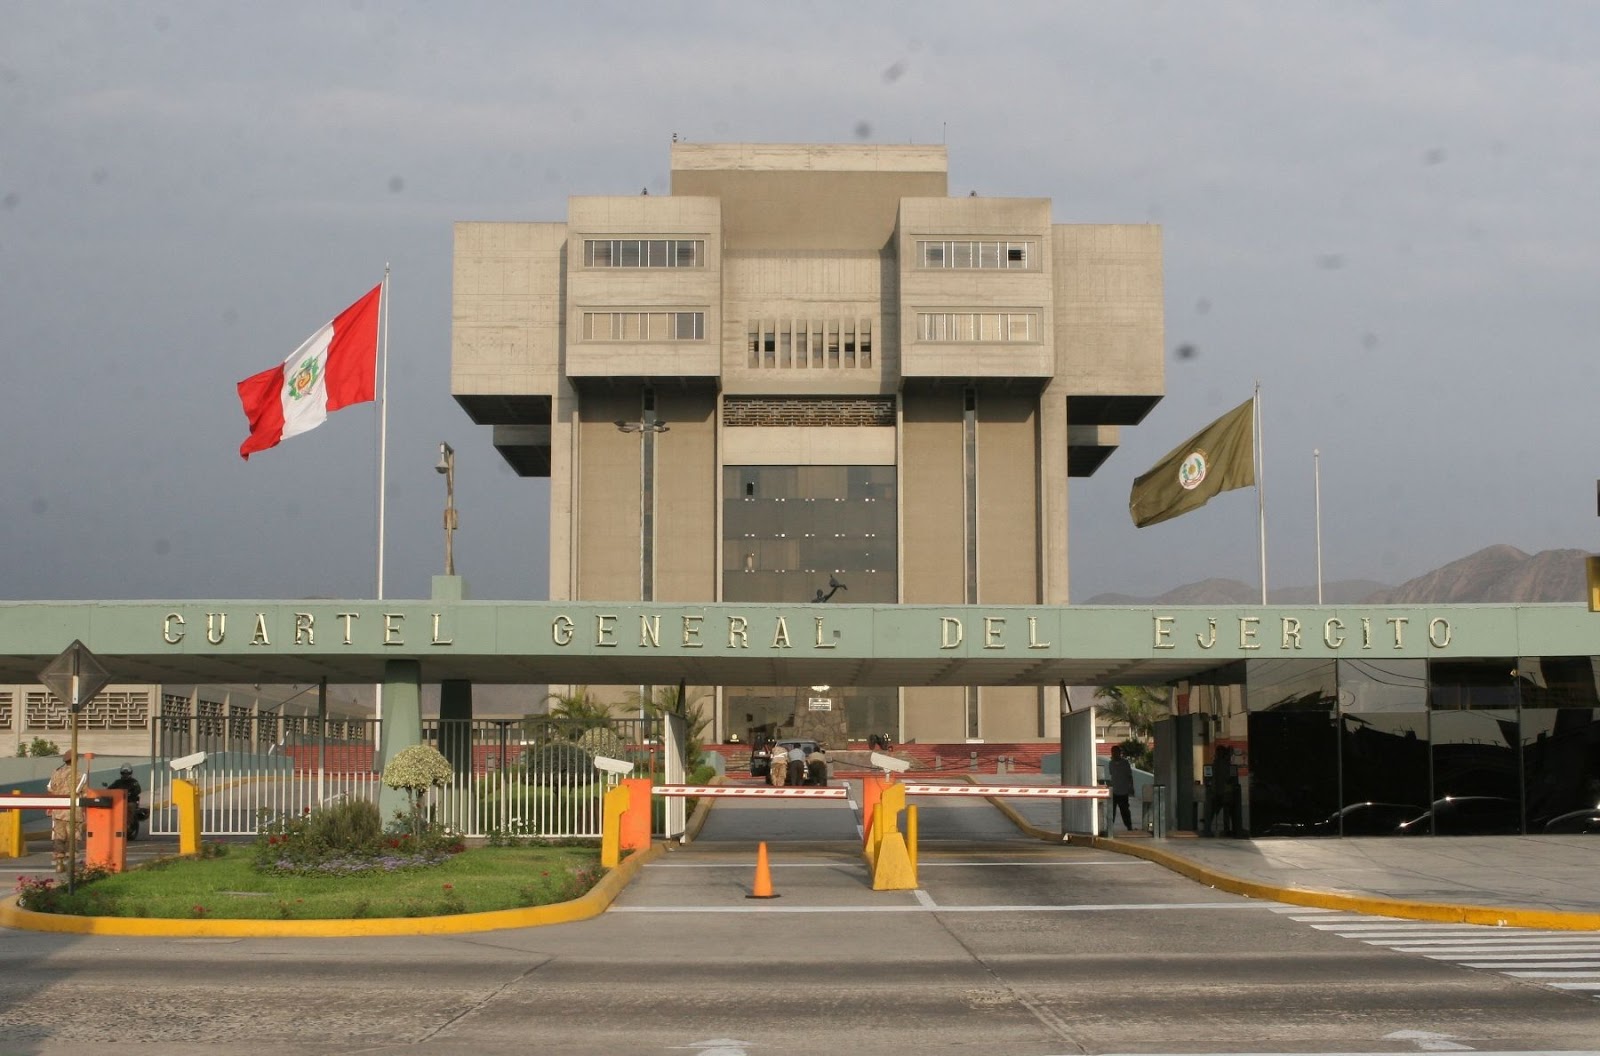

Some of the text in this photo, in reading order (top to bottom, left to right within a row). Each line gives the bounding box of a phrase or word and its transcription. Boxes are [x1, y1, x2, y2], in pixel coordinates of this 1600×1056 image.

[163, 612, 1451, 649] CUARTEL GENERAL DEL EJERCITO
